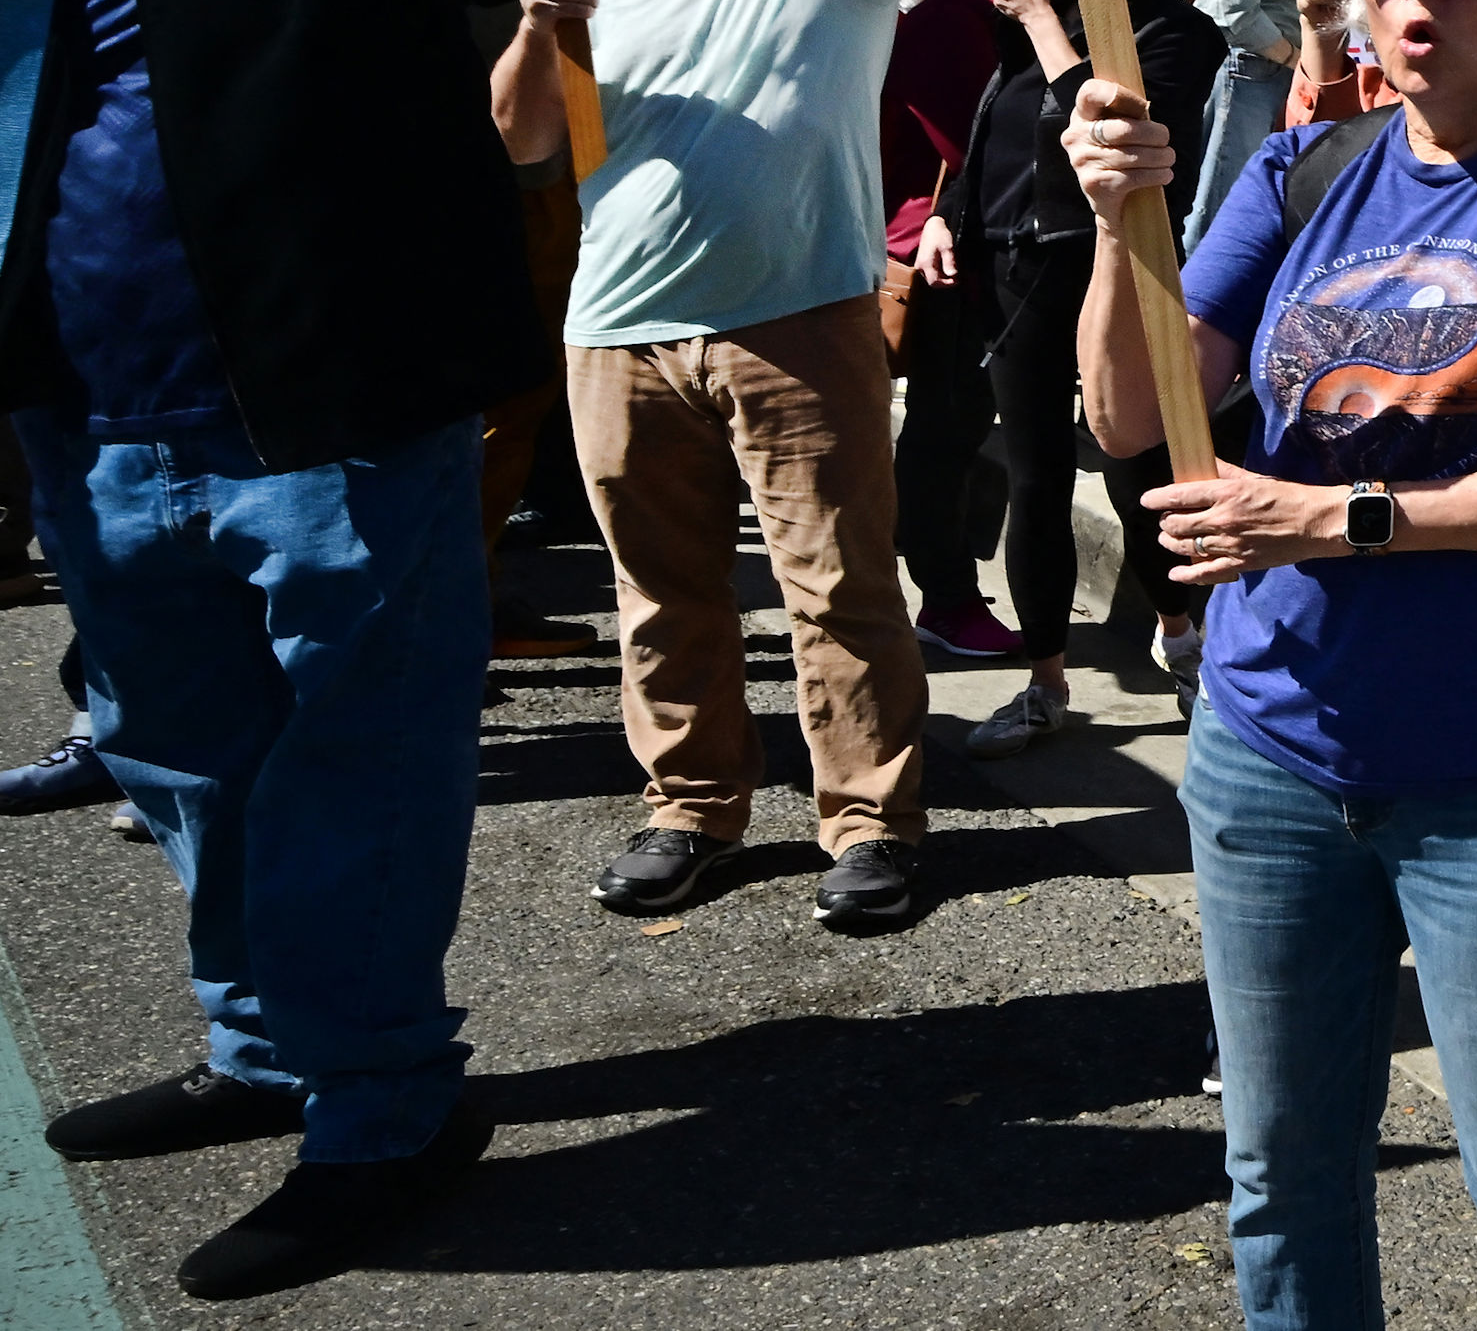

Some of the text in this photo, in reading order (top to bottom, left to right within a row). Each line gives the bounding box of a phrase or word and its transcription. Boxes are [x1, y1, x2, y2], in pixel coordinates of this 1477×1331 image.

[1277, 264, 1329, 318] ANON
[1333, 252, 1358, 270] OF
[1361, 244, 1401, 260] THE
